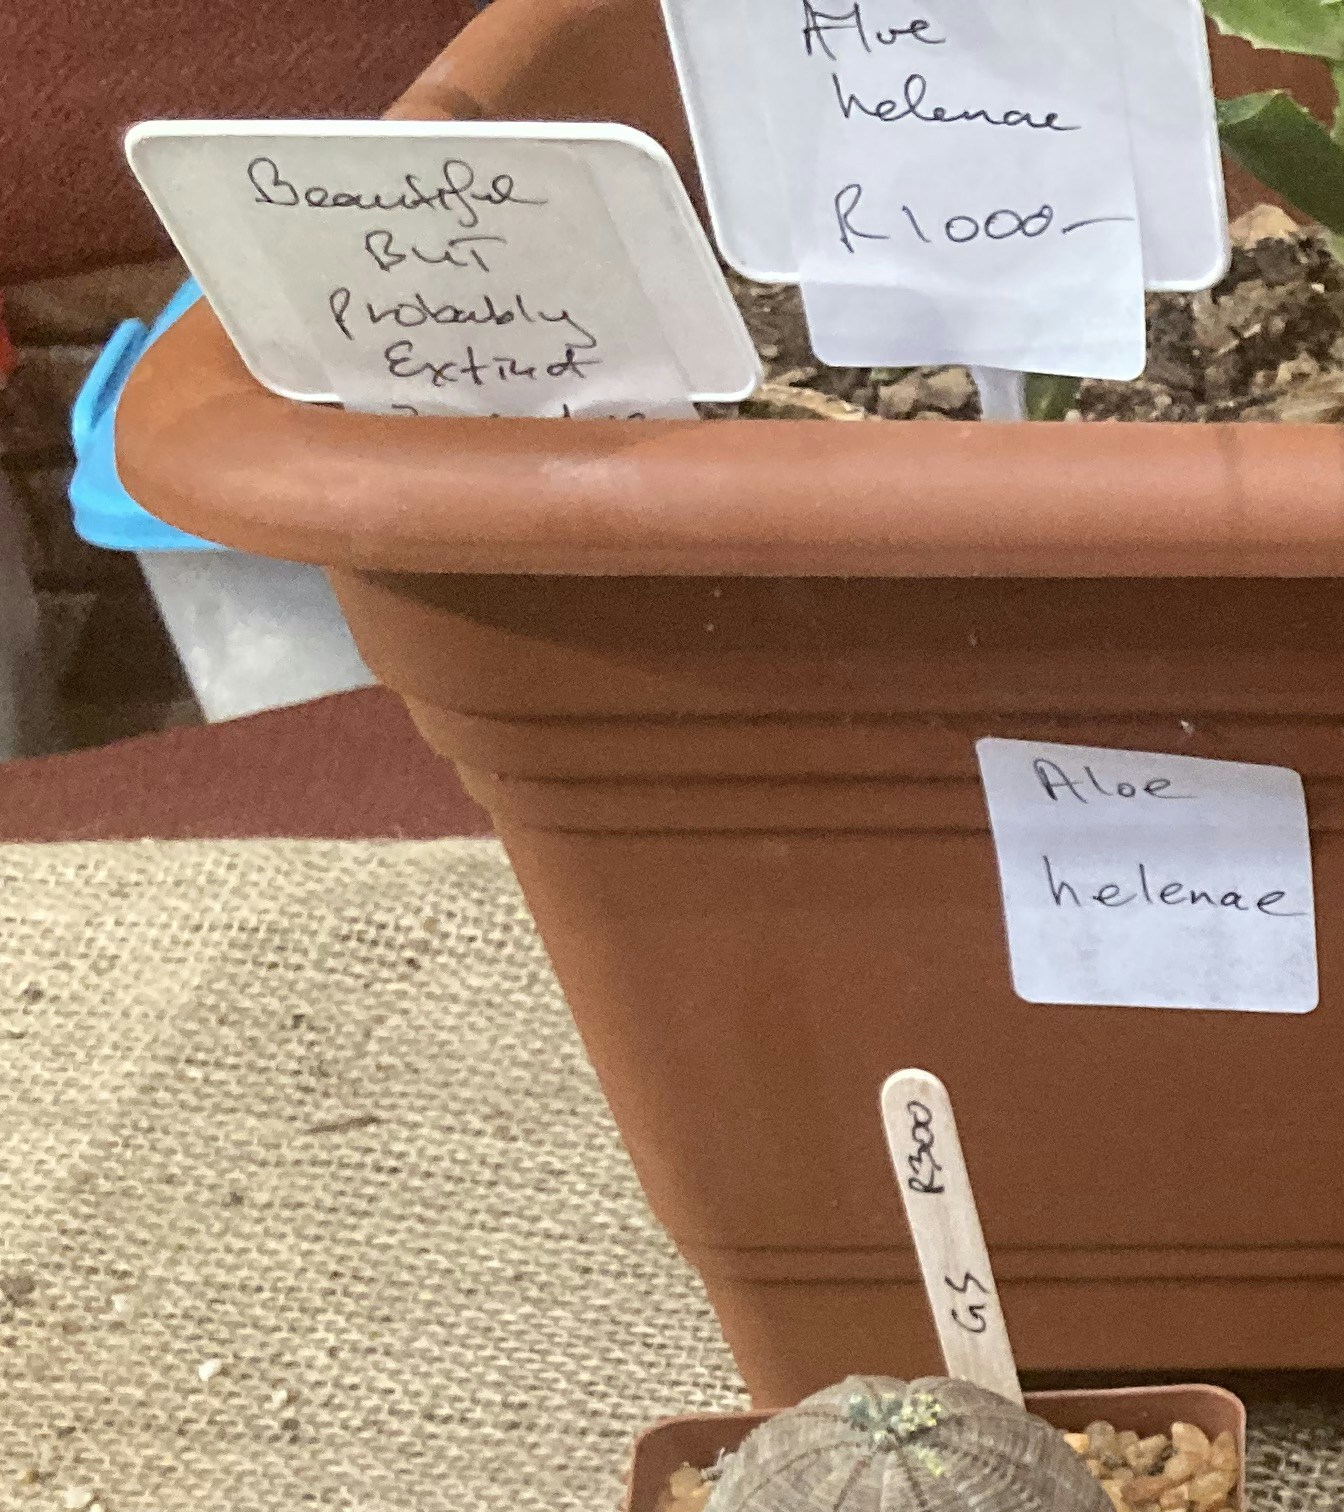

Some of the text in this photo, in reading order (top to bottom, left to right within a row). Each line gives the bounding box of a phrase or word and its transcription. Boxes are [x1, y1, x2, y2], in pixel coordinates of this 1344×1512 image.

[804, 2, 947, 60] Aloe
[832, 73, 1082, 132] helenae
[328, 286, 597, 347] Probably
[384, 340, 602, 386] Extinct
[1032, 758, 1199, 804] Aloe
[1043, 855, 1308, 917] helenae
